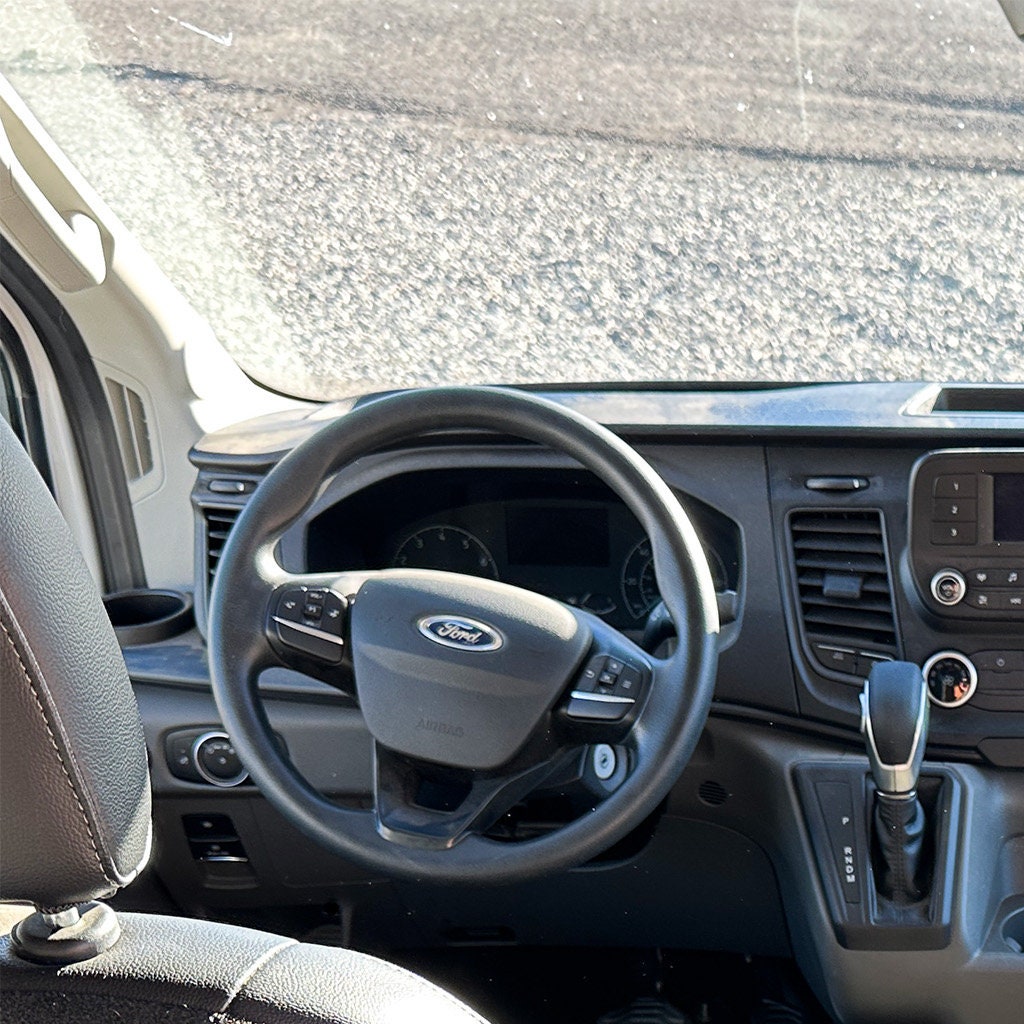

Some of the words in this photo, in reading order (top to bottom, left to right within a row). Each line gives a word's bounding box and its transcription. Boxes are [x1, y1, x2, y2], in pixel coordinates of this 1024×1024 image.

[437, 621, 483, 645] Ford
[842, 817, 849, 825] P
[844, 846, 852, 855] R
[844, 856, 853, 864] N
[846, 865, 854, 874] D
[846, 874, 855, 883] M
